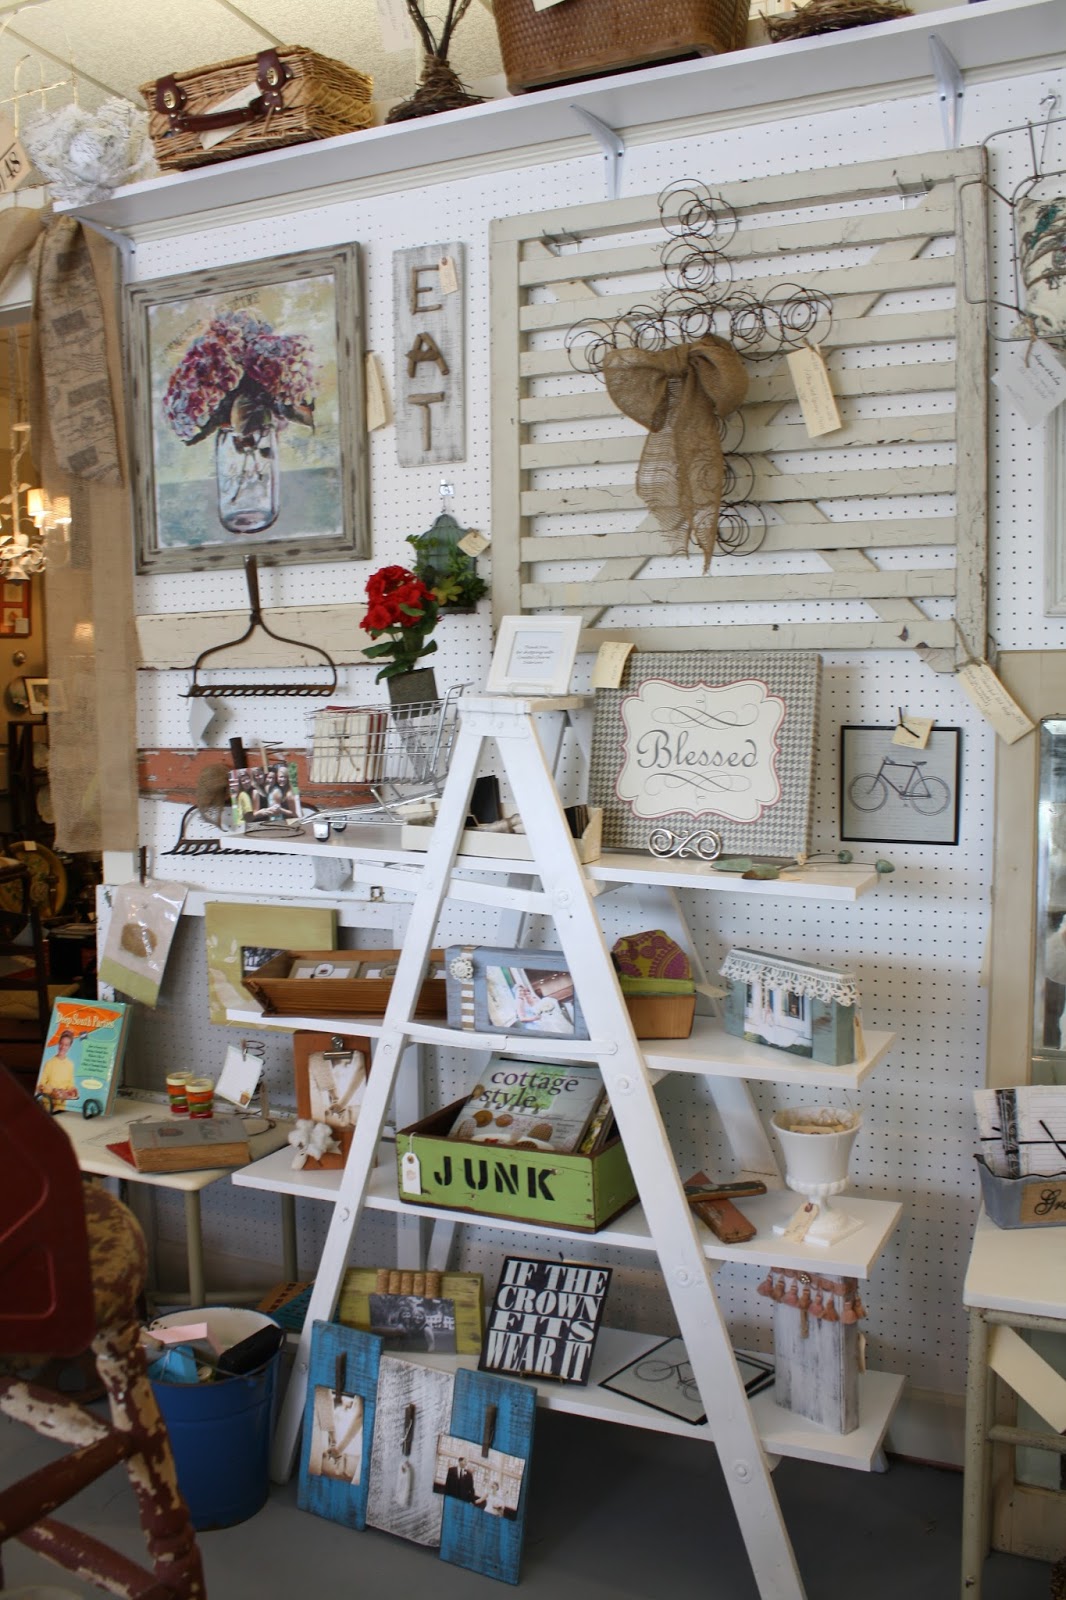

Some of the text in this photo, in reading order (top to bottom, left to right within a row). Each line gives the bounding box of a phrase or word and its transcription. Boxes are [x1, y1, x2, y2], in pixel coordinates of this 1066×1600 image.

[405, 264, 449, 451] EAT
[637, 729, 758, 769] Blessed
[480, 1087, 538, 1109] style
[491, 1071, 579, 1095] cottage
[433, 1156, 556, 1201] JUNK
[502, 1260, 609, 1297] IF THE
[497, 1286, 603, 1321] CROWN
[490, 1310, 595, 1342] FITS
[486, 1329, 593, 1381] WEAR IT
